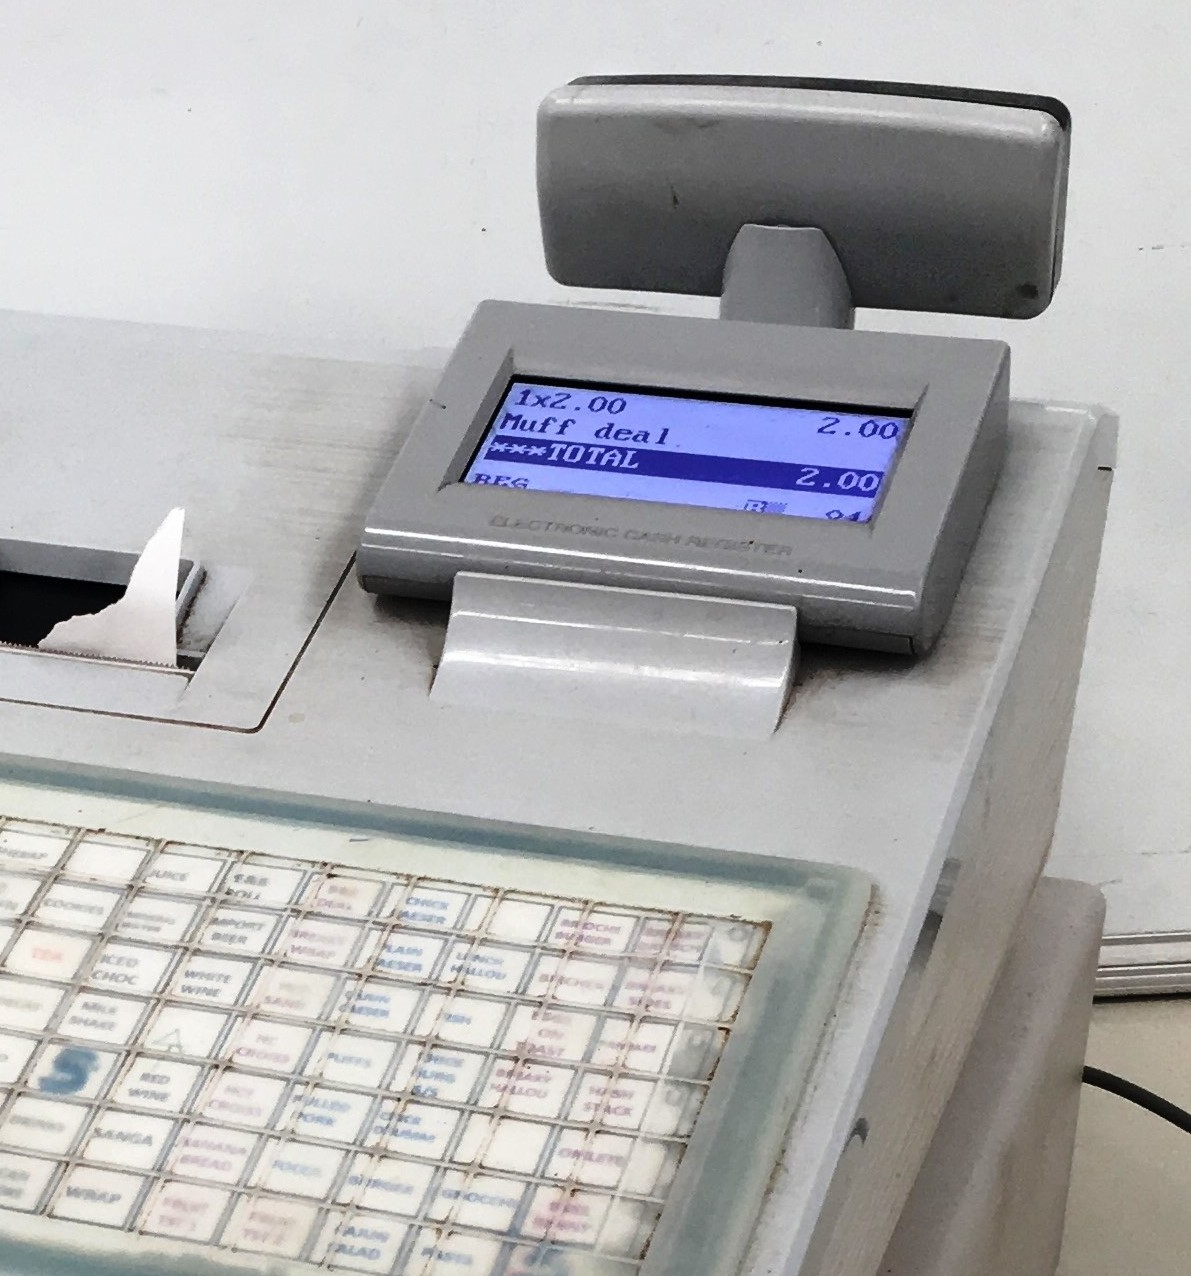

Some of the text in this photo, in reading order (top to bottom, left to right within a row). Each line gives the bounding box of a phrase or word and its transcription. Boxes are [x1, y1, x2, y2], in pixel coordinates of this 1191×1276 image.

[515, 389, 627, 415] 1x2.00
[500, 412, 669, 446] Muff deal
[817, 416, 899, 440] 2.00
[796, 467, 880, 491] 2.00
[489, 514, 618, 538] ELECTRONIC
[623, 525, 681, 545] CASH
